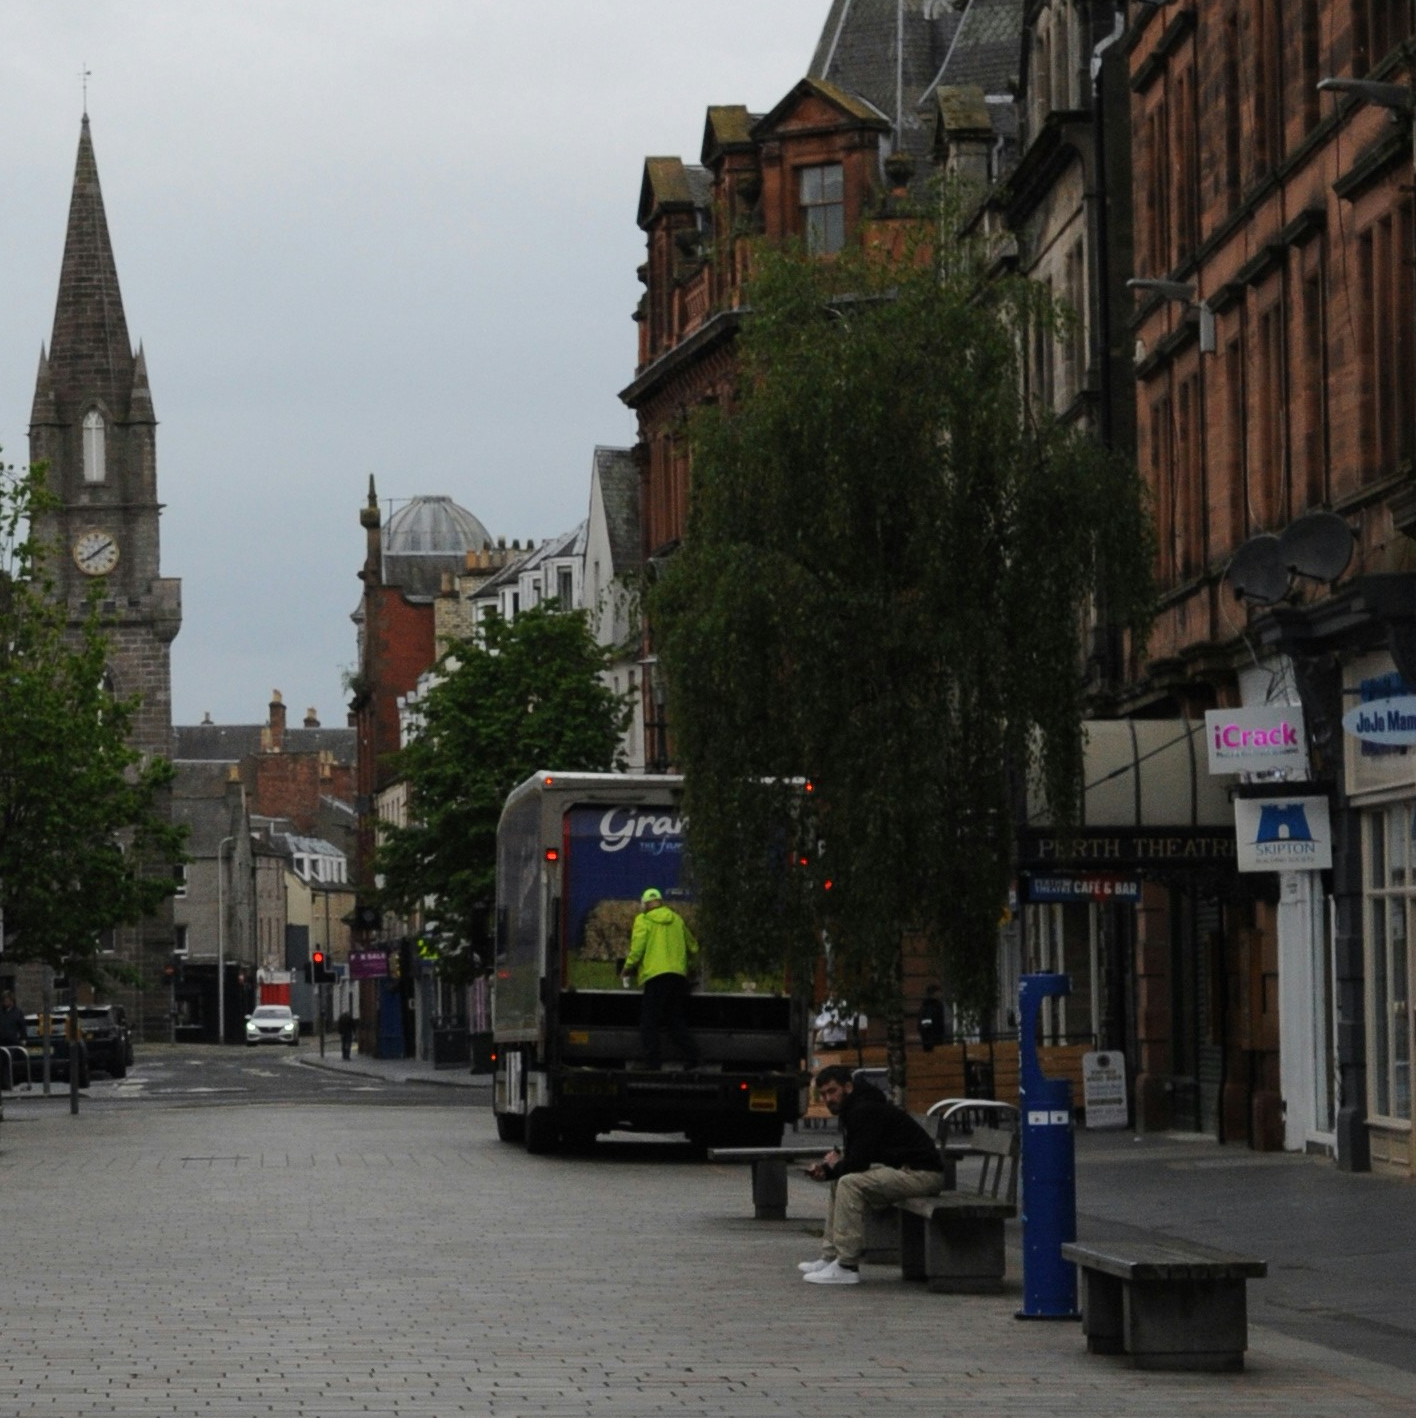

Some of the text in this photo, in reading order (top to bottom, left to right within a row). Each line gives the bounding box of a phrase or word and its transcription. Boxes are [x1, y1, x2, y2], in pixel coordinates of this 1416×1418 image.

[1215, 722, 1298, 749] iCrack
[1256, 842, 1315, 856] SKIPTON
[1103, 881, 1112, 894] &
[1114, 881, 1137, 895] BAR
